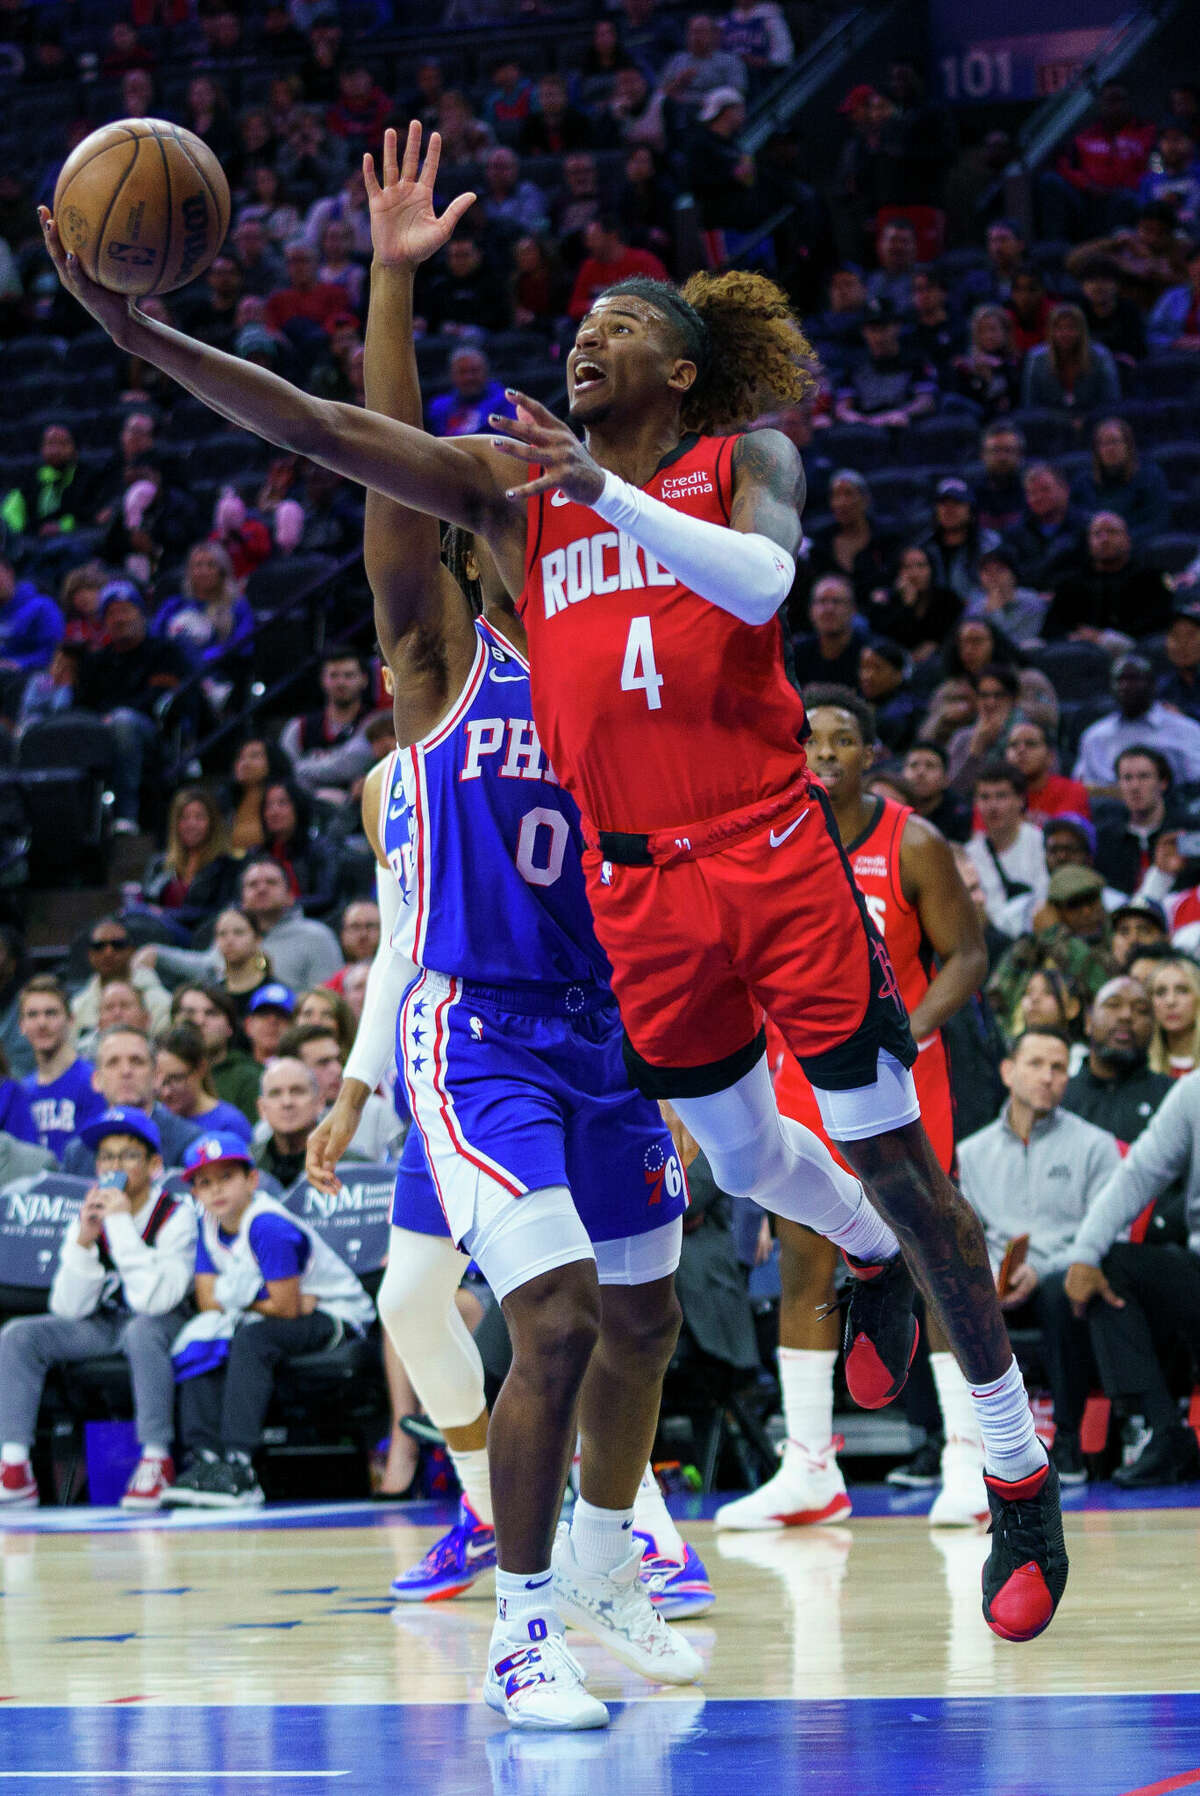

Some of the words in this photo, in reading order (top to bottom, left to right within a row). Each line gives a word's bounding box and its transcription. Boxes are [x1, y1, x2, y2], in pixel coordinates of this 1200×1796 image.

[941, 51, 1012, 97] 101
[661, 480, 713, 500] karma
[663, 471, 708, 490] credit
[620, 615, 664, 711] 4
[515, 806, 570, 888] 0
[644, 1155, 682, 1207] 76
[7, 1193, 64, 1226] NJM
[304, 1184, 364, 1218] NJM
[527, 1617, 548, 1641] 0
